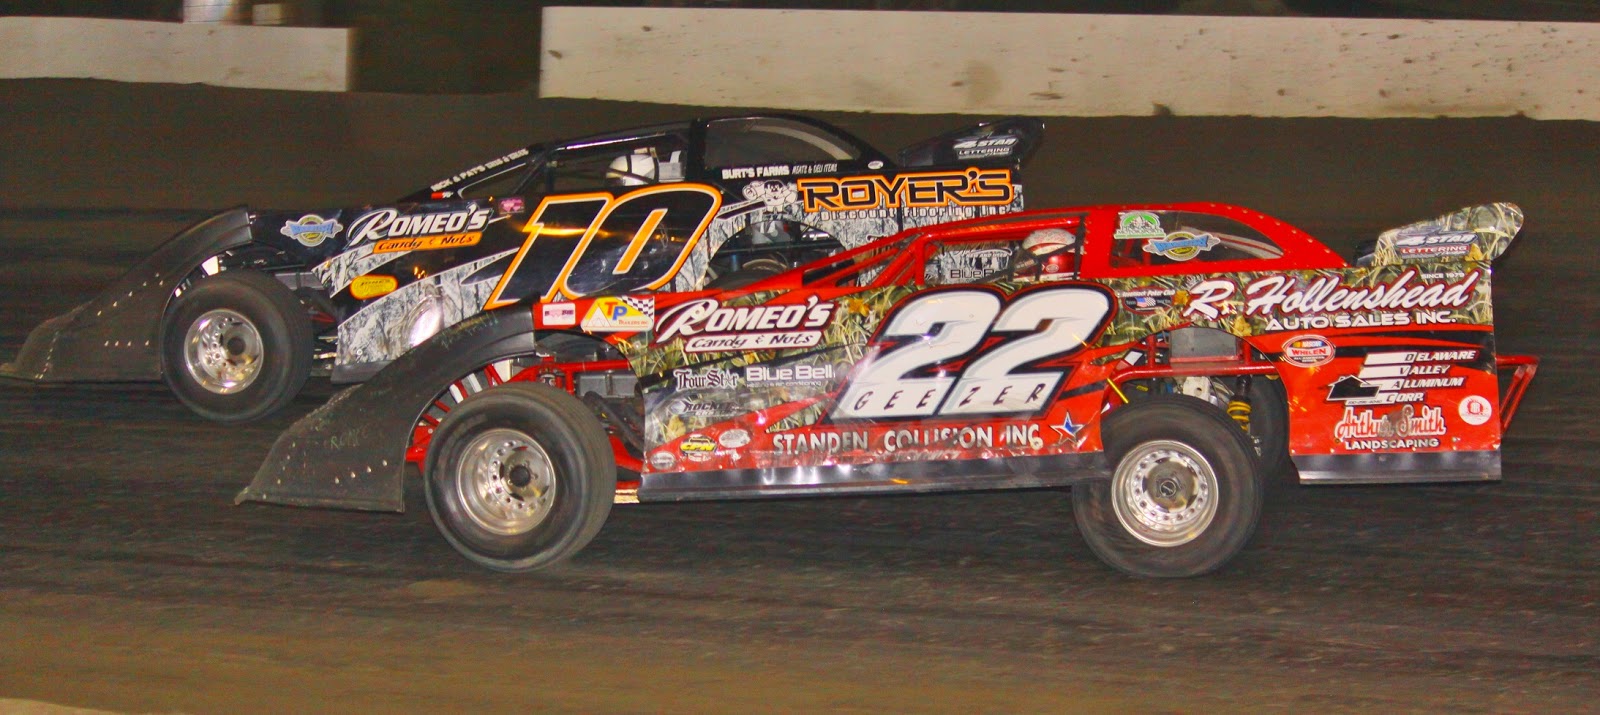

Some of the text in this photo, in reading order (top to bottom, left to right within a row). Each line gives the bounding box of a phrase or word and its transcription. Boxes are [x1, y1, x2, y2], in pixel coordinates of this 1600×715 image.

[959, 147, 1010, 155] LETTERING
[722, 168, 755, 179] BURT'S
[757, 165, 790, 177] FARMS
[797, 167, 1014, 212] ROYER'S
[820, 207, 896, 221] Discount
[903, 205, 973, 218] Flooring
[346, 202, 492, 247] ROMEO'S
[440, 231, 475, 245] Nuts
[483, 182, 722, 310] 10
[1401, 245, 1467, 254] LETTERING
[1246, 269, 1481, 316] Hollenshead
[656, 295, 835, 344] ROMEO'S
[1264, 310, 1457, 331] AUTO SALES INC.
[691, 336, 748, 349] Candy
[769, 332, 816, 346] Nuts
[826, 284, 1114, 421] 22
[1404, 351, 1476, 362] DELAWARE
[746, 364, 833, 382] Blue Bell
[1399, 365, 1451, 375] VALLEY
[1391, 377, 1466, 389] ALUMINUM
[854, 383, 1046, 411] GEEZER
[773, 431, 869, 454] STANDEN
[1345, 438, 1440, 450] LANDSCAPING
